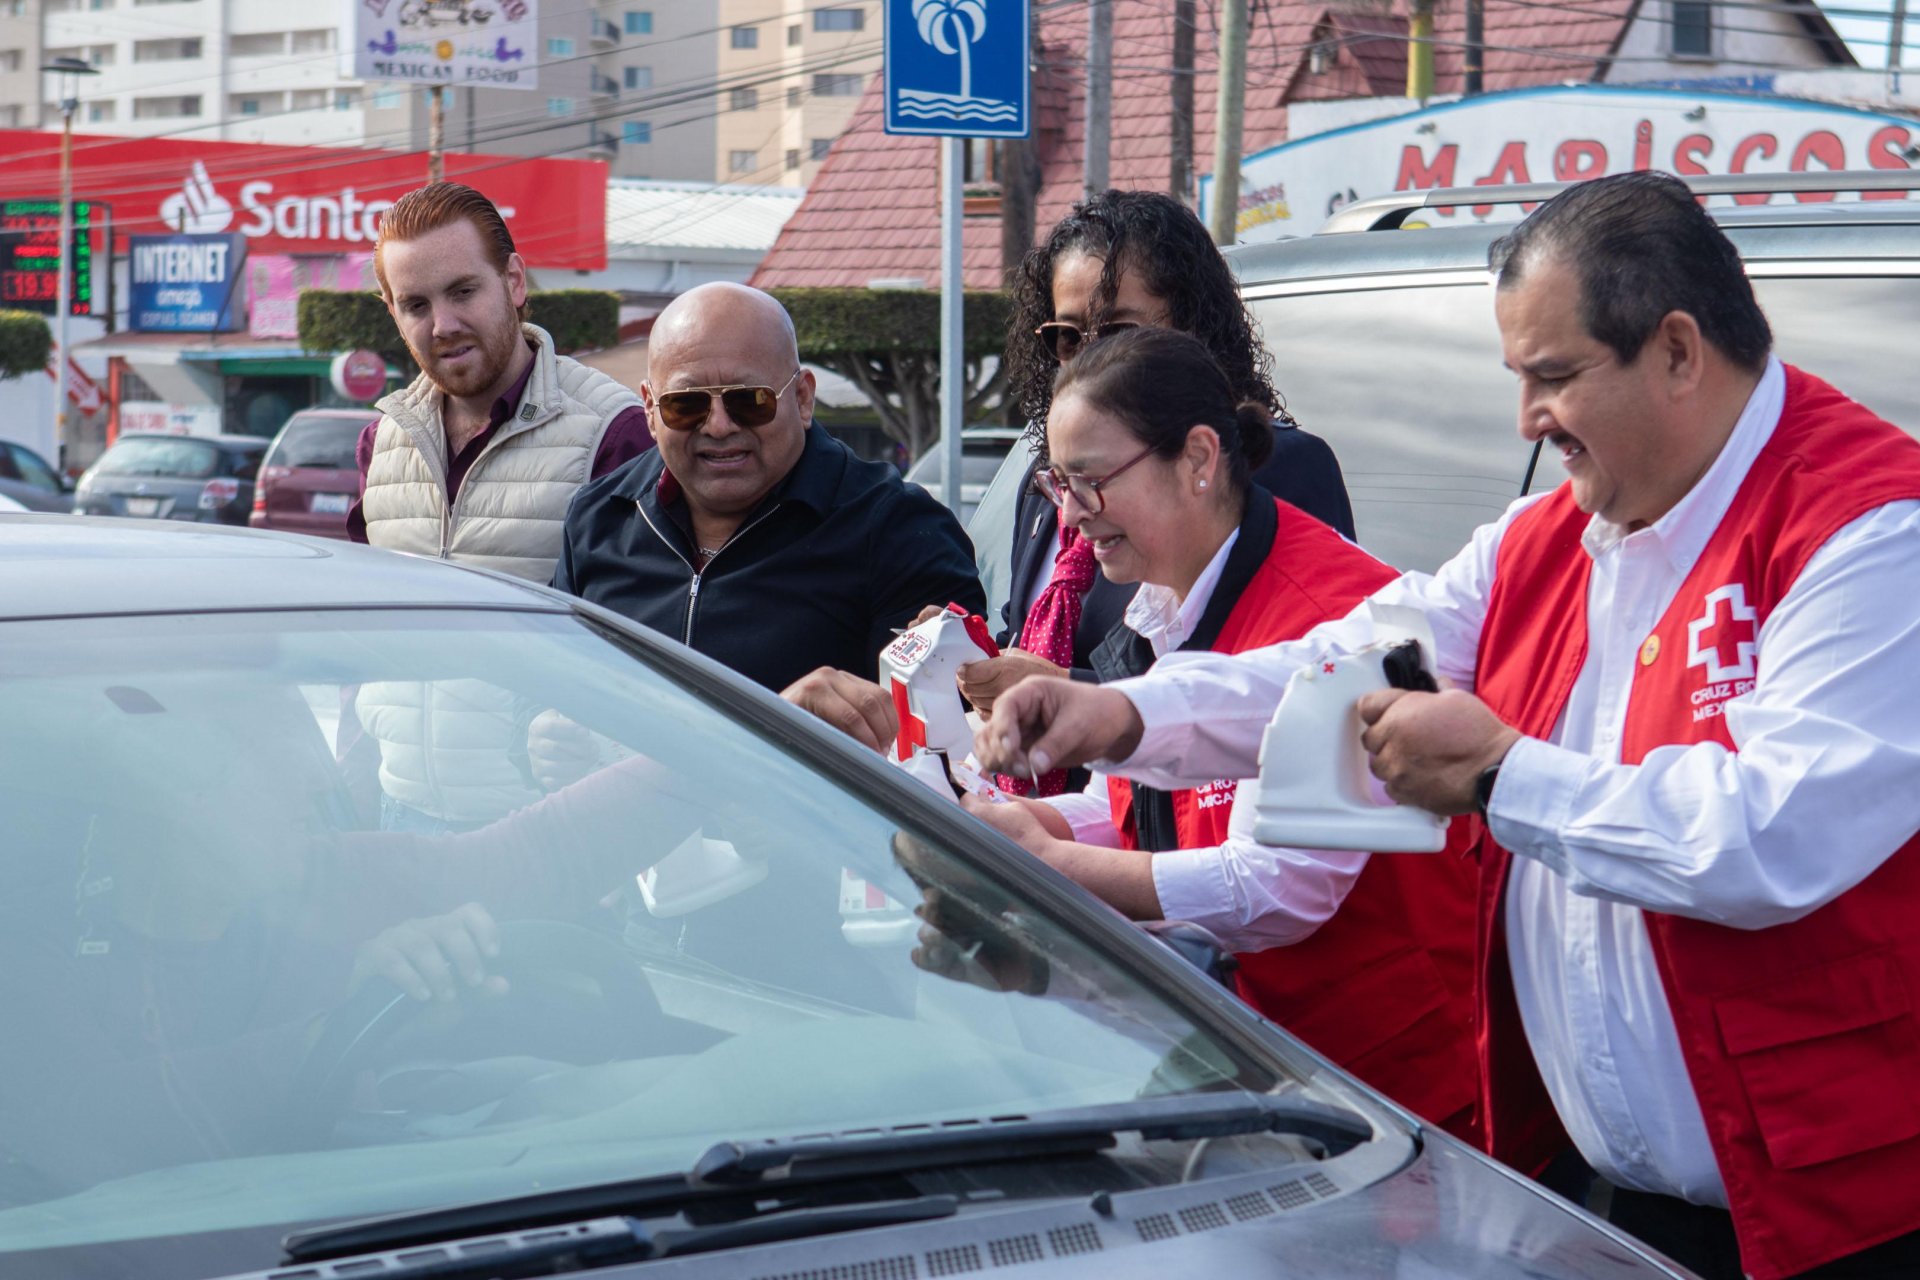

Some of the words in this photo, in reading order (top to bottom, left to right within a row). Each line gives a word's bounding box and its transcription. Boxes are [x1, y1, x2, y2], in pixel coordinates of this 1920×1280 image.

[373, 62, 453, 79] MEXICAN
[466, 67, 519, 82] FOOD
[133, 243, 229, 283] INTERNET
[1690, 684, 1731, 704] CRUZ
[1734, 681, 1756, 696] RO
[1693, 702, 1725, 722] MEX
